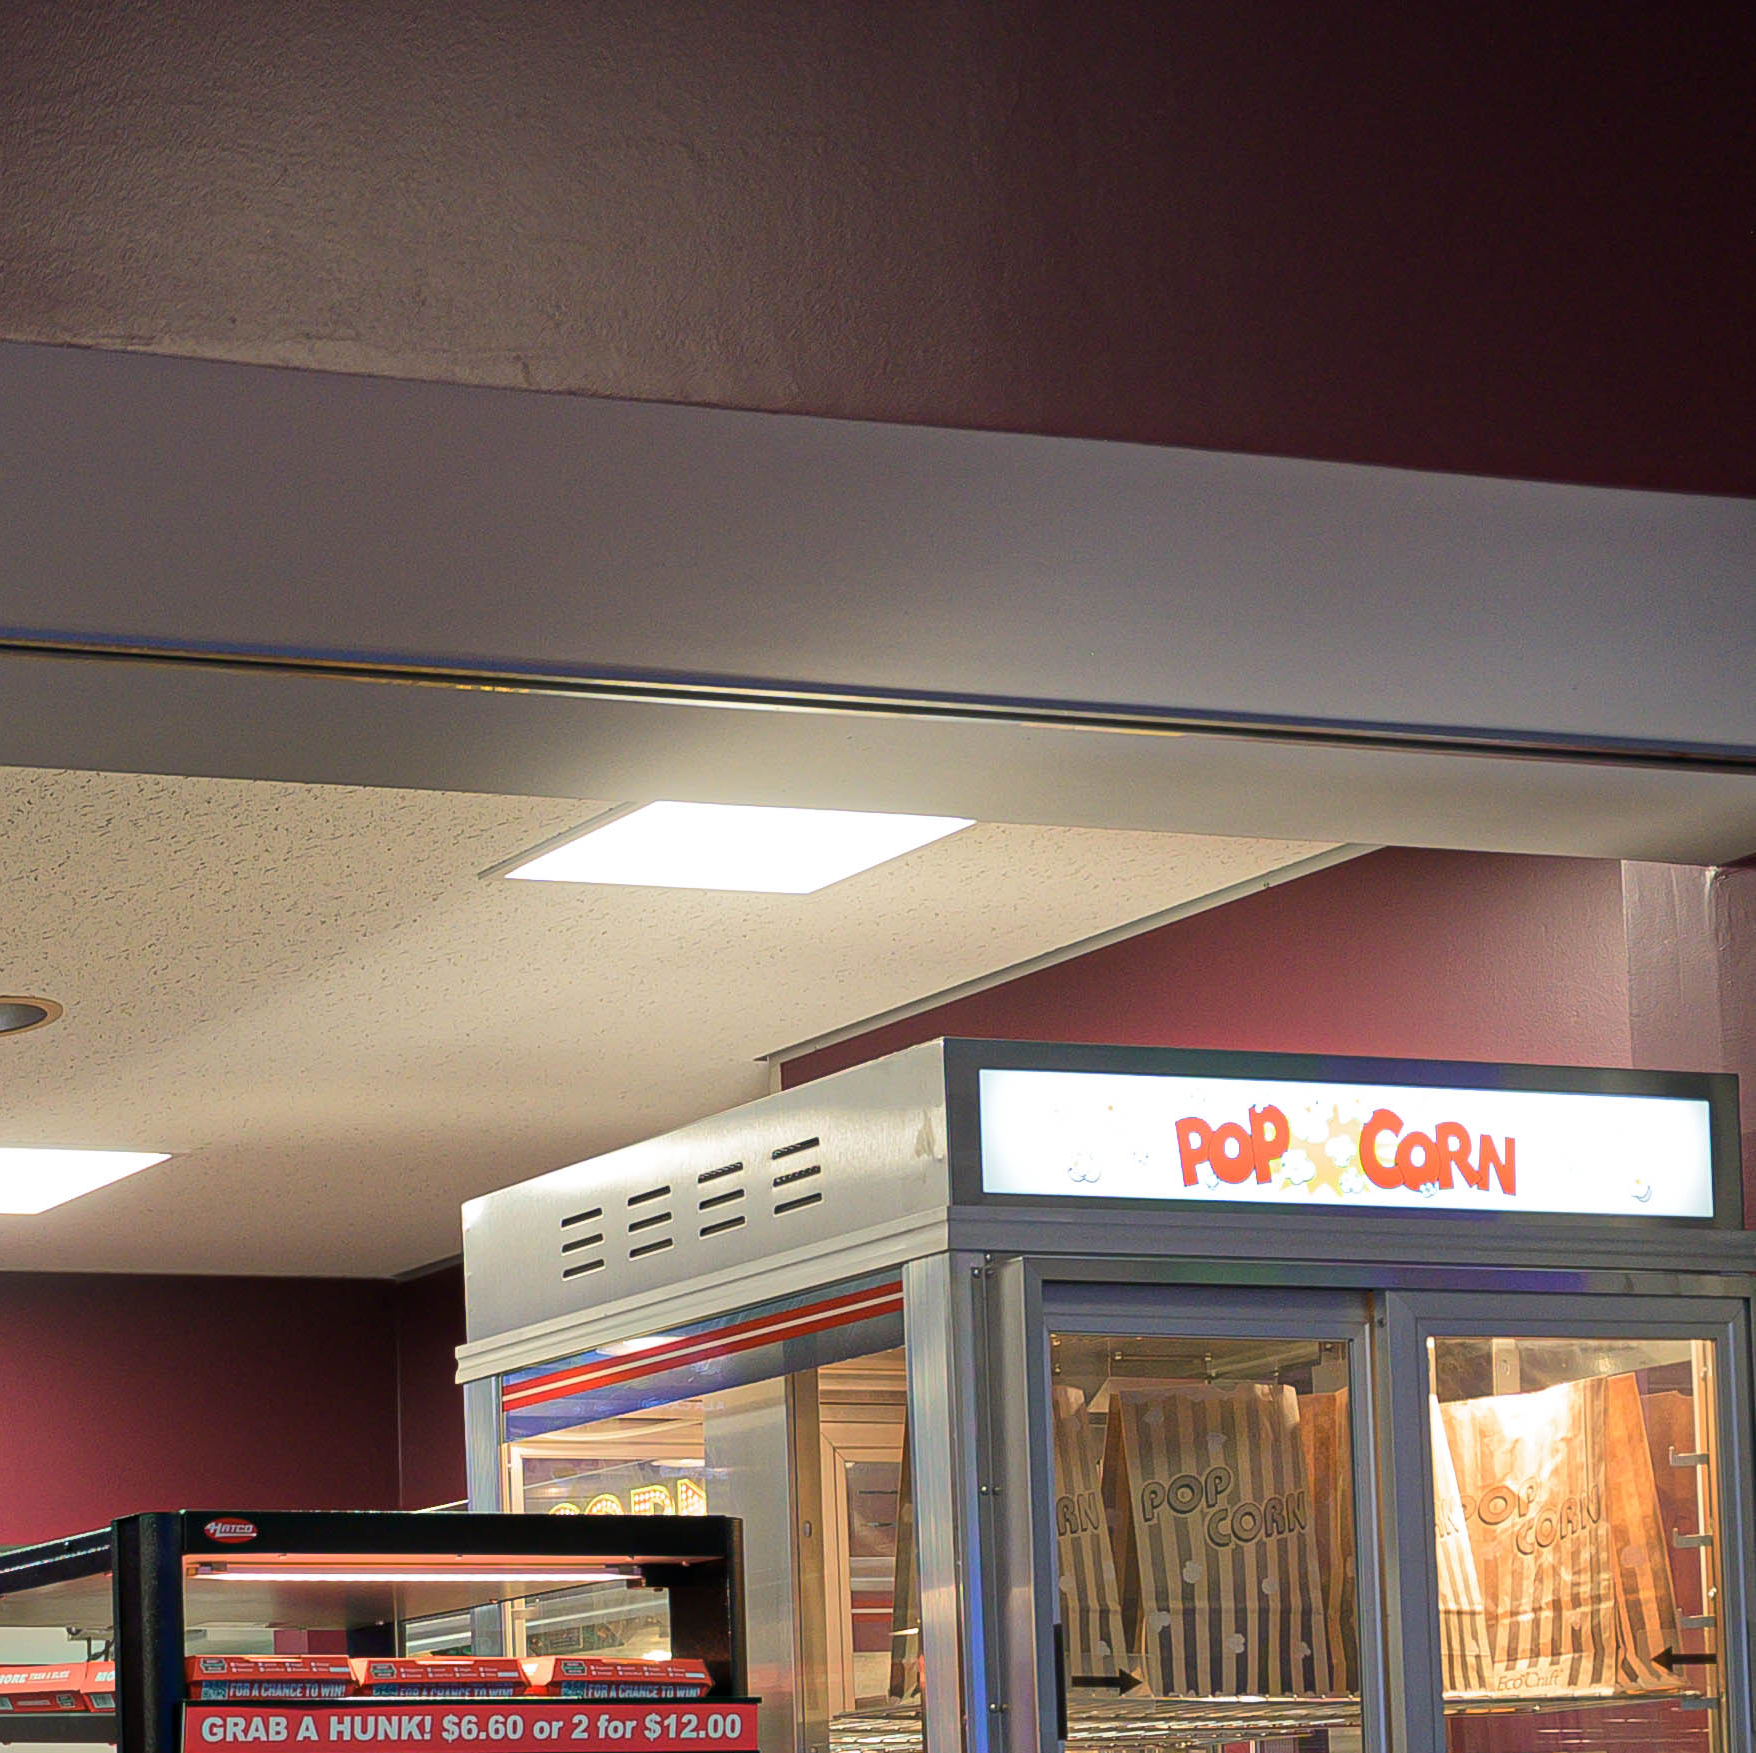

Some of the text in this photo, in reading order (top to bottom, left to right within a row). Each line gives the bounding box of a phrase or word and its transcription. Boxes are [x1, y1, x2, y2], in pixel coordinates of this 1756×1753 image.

[1175, 1104, 1516, 1196] POP CORN
[1141, 1466, 1231, 1522] POP
[1207, 1490, 1307, 1548] CORN
[1516, 1484, 1602, 1556] CORN
[206, 1521, 257, 1538] HATCO
[230, 1683, 250, 1697] FOR
[252, 1683, 259, 1697] A
[260, 1683, 303, 1697] CHANCE
[305, 1683, 318, 1697] TO
[202, 1713, 741, 1743] GRAB A HUNK! $6.60 or 2 for $12.00
